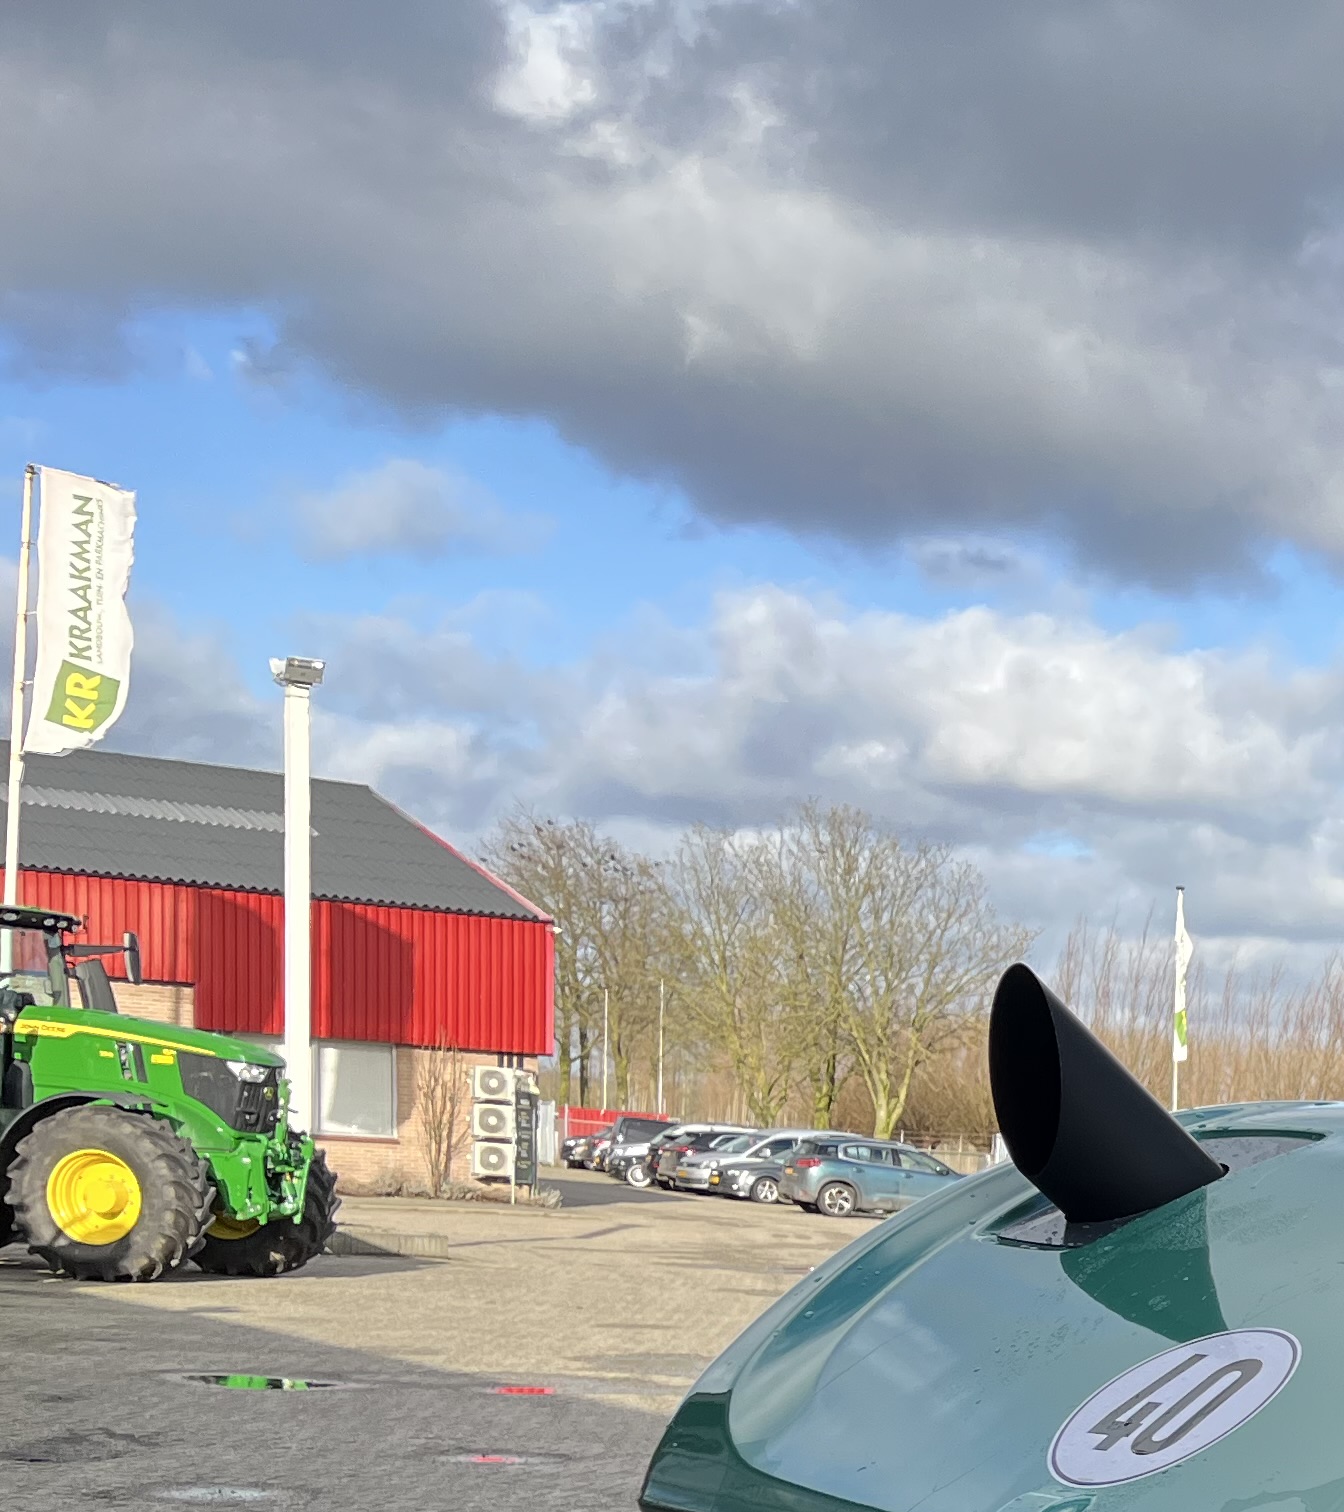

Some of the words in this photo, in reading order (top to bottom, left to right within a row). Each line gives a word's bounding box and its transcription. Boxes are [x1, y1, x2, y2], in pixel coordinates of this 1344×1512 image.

[68, 494, 95, 662] KRAAKMAN
[62, 672, 102, 729] KR
[1087, 1353, 1263, 1455] 40
